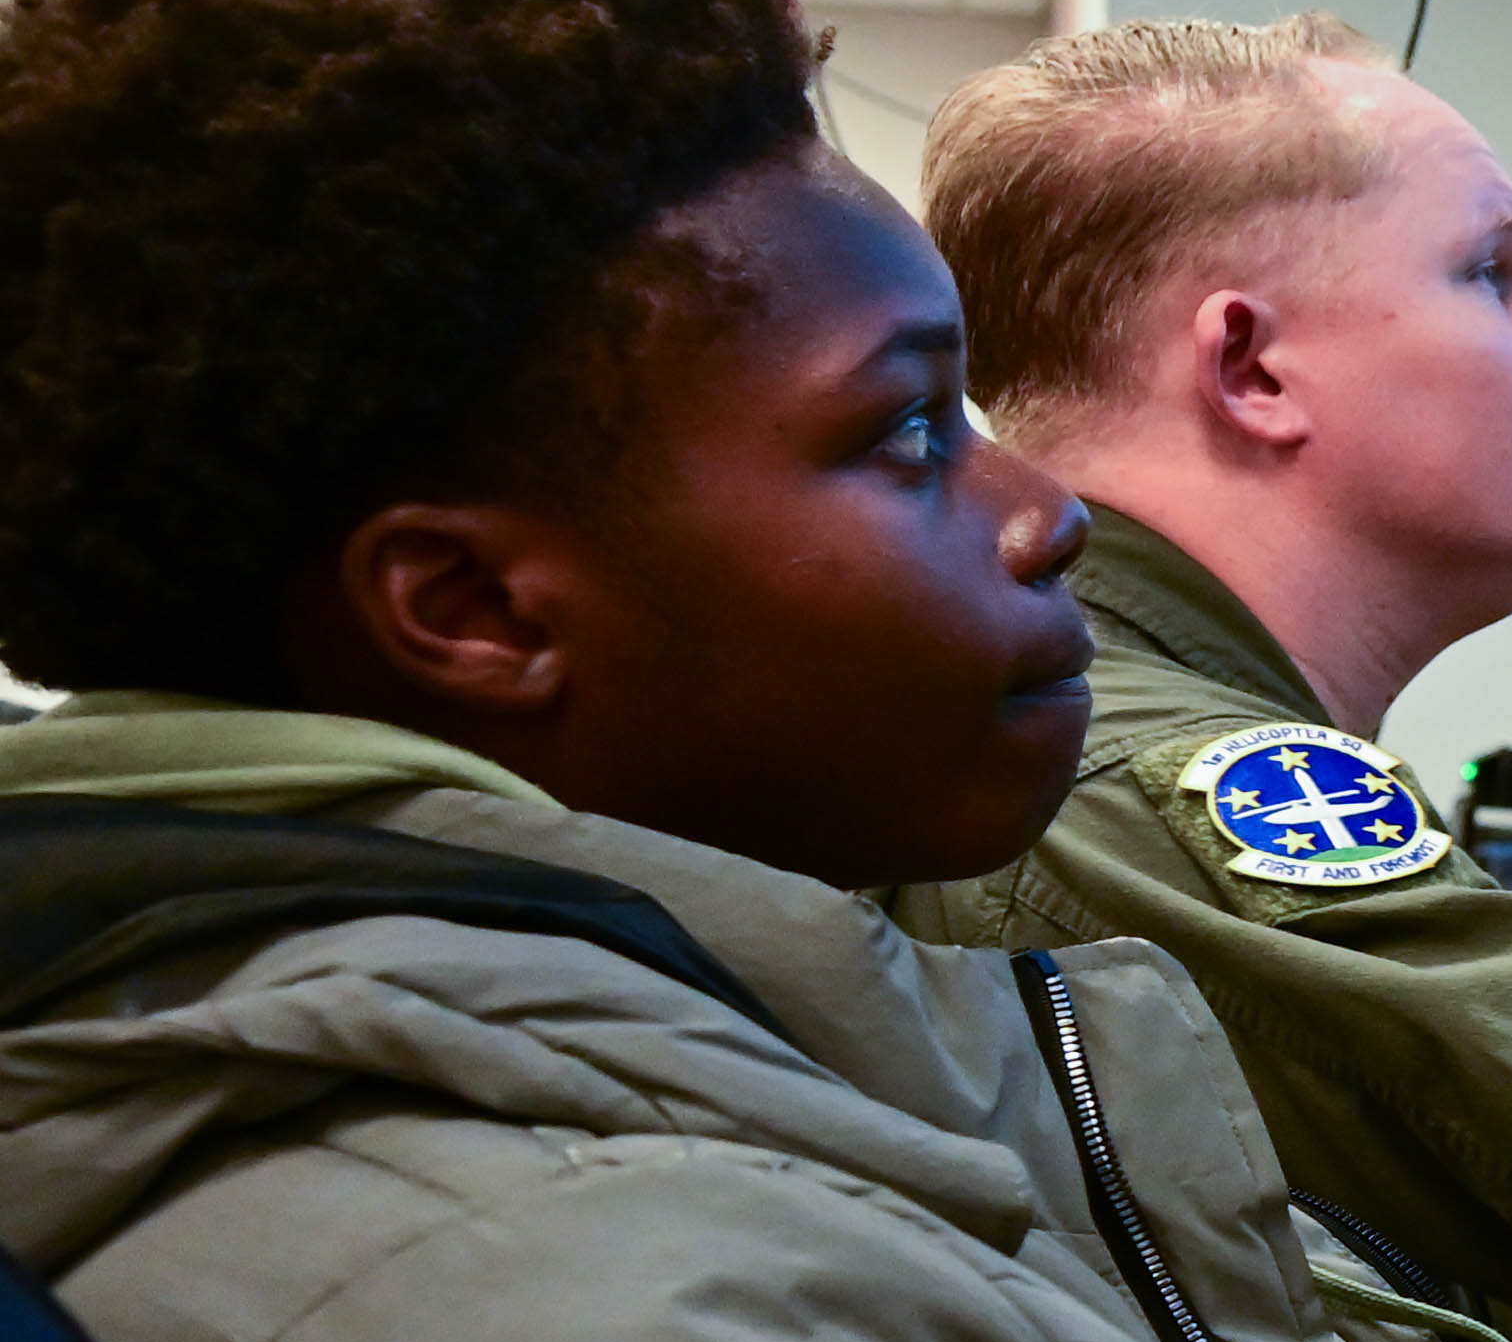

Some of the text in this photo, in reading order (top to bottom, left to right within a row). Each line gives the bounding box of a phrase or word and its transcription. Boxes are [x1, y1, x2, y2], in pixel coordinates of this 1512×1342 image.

[1222, 727, 1328, 755] HELICOPTER
[1255, 837, 1440, 881] FIRST AND FOREMOST
